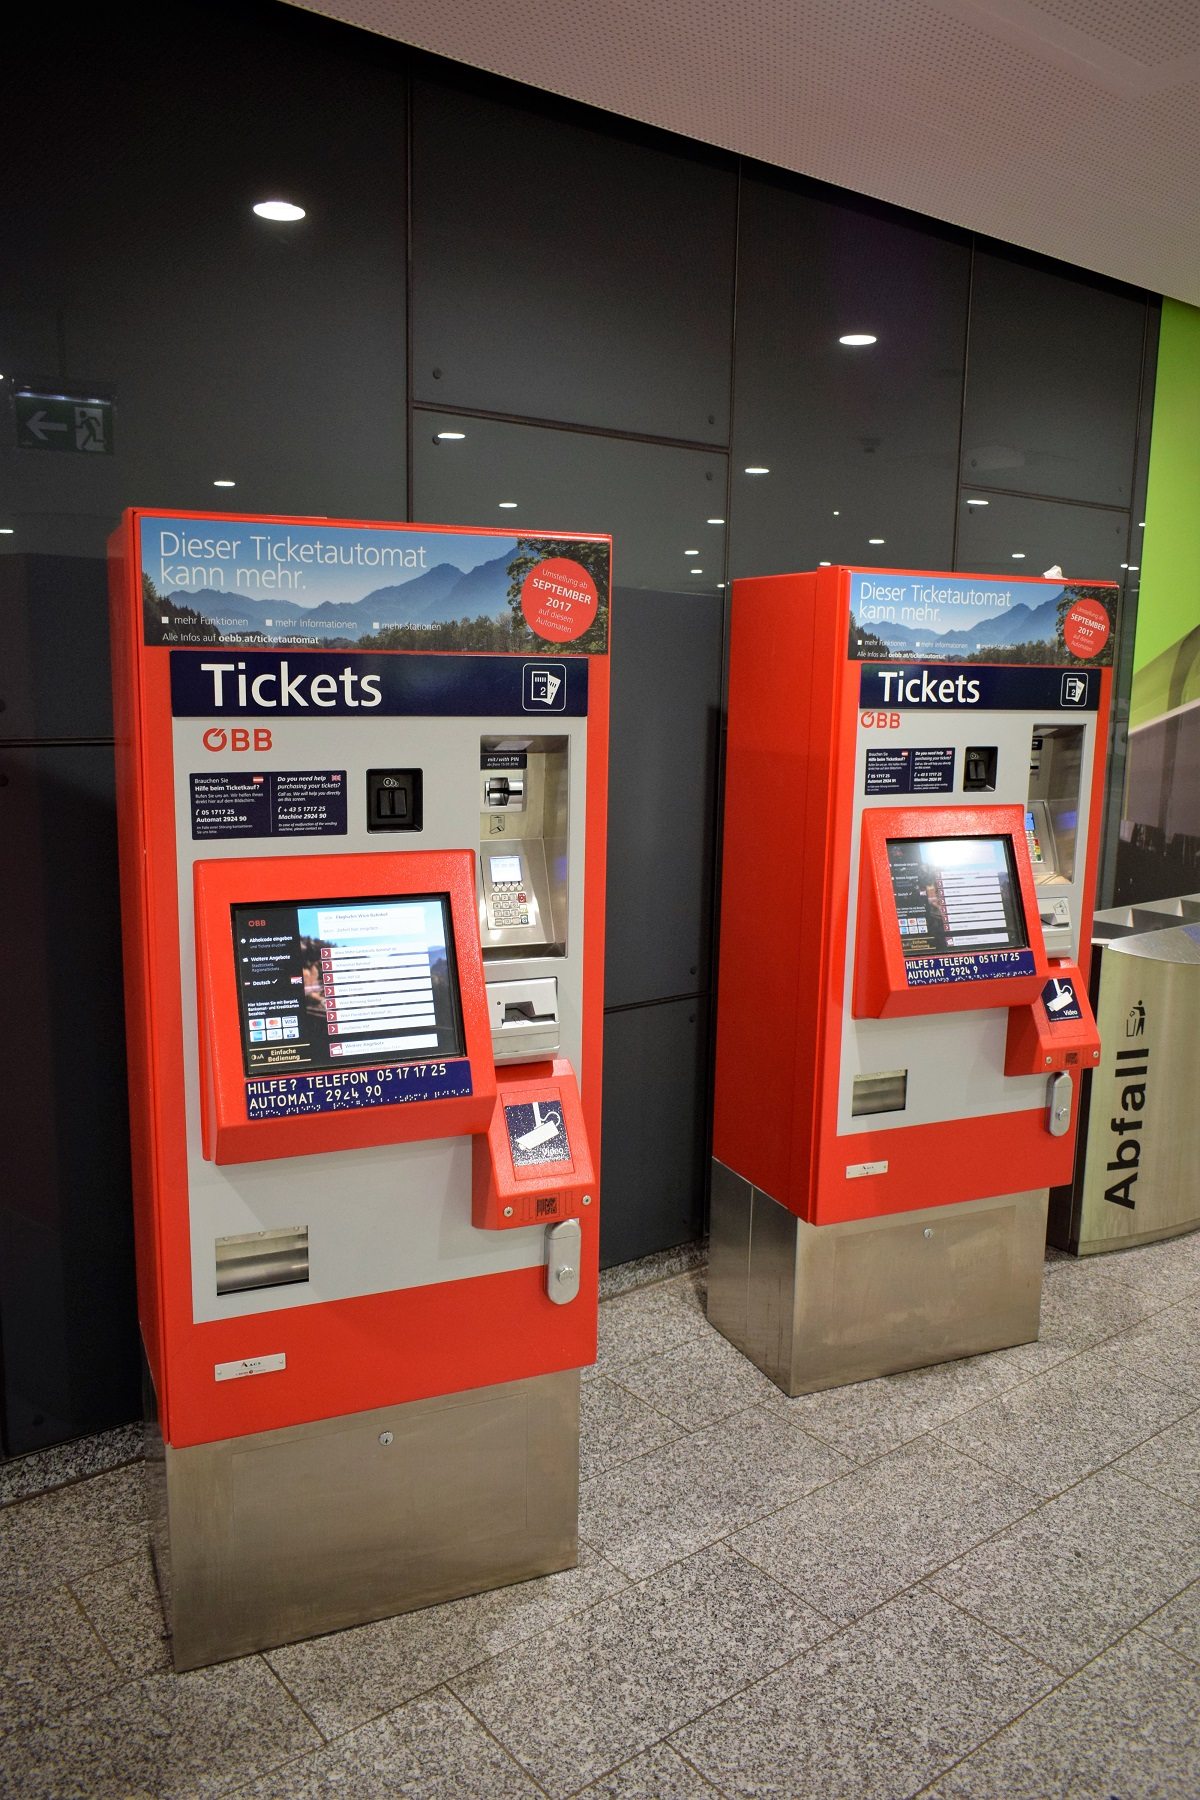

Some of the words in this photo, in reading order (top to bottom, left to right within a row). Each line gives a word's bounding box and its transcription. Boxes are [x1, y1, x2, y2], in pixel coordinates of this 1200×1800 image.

[160, 531, 241, 560] Dieser
[250, 536, 427, 568] Ticketautomat
[160, 558, 225, 586] kann
[236, 563, 307, 590] mehr.
[542, 569, 578, 587] Umstellung
[579, 581, 588, 589] ab
[532, 578, 592, 605] SEPTEMBER
[860, 582, 906, 602] Dieser
[912, 584, 1011, 607] Ticketautomat
[546, 597, 572, 612] 2017
[859, 600, 895, 620] kann
[901, 604, 941, 623] mehr.
[174, 616, 197, 625] mehr
[200, 616, 249, 627] Funktionen
[275, 618, 297, 628] mehr
[300, 619, 358, 630] Informationen
[535, 616, 573, 634] Automaten
[539, 608, 550, 616] auf
[551, 611, 574, 624] diesem
[1071, 613, 1106, 632] SEPTEMBER
[382, 622, 402, 630] mehr
[404, 621, 442, 632] Stationen
[1078, 626, 1094, 637] 2017
[162, 633, 179, 642] Alle
[181, 633, 200, 643] Infos
[202, 633, 216, 643] auf
[218, 634, 319, 645] oebb.at/ticketautomat
[200, 661, 382, 708] Tickets
[540, 686, 547, 696] 2
[878, 670, 980, 704] Tickets
[861, 711, 901, 729] ÖBB
[203, 727, 273, 752] ÖBB
[906, 958, 934, 970] HILFE?
[939, 956, 975, 967] TELEFON
[979, 954, 989, 964] 05
[991, 954, 1000, 963] 17
[1000, 953, 1008, 962] 17
[1010, 952, 1020, 961] 25
[908, 969, 945, 980] AUTOMAT
[950, 967, 971, 977] 2924
[973, 966, 979, 974] 9
[268, 1055, 301, 1063] Bedienung
[248, 1079, 297, 1095] HILFE?
[306, 1072, 369, 1089] TELEFON
[377, 1068, 393, 1081] 05
[396, 1066, 410, 1080] 17
[413, 1065, 427, 1079] 17
[431, 1063, 447, 1076] 25
[249, 1092, 315, 1110] AUTOMAT
[365, 1084, 382, 1097] 90
[1103, 1047, 1150, 1211] Abfall
